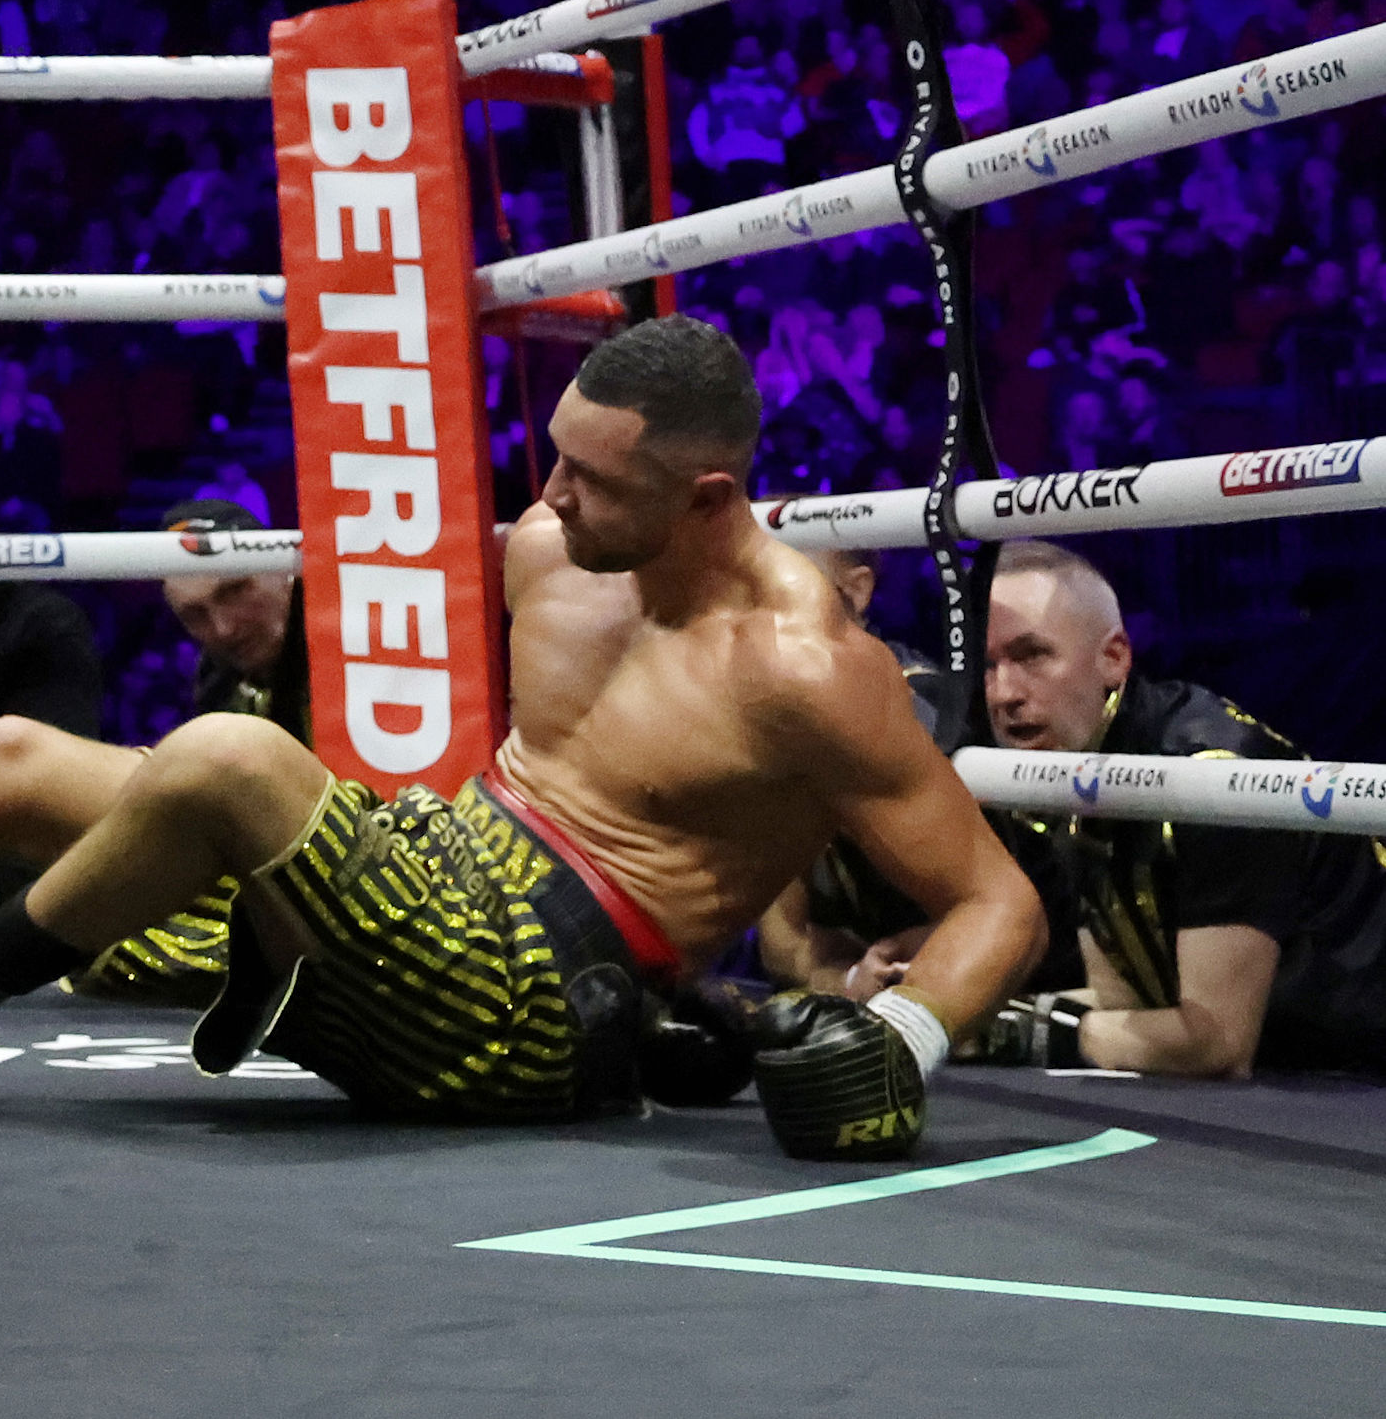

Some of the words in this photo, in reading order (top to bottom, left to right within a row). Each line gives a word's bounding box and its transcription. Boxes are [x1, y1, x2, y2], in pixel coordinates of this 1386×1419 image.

[1168, 88, 1233, 125] RIYADH
[1275, 58, 1347, 96] SEASON
[966, 149, 1020, 180] RIYADH
[1052, 123, 1111, 157] SEASON
[306, 68, 452, 773] BETFRED
[1224, 440, 1359, 488] BETFRED
[994, 466, 1142, 518] BOXXER
[936, 549, 965, 672] SEASON
[1012, 763, 1069, 783] RIYADH
[1106, 767, 1167, 787] SEASON
[1228, 771, 1297, 795] RIYADH
